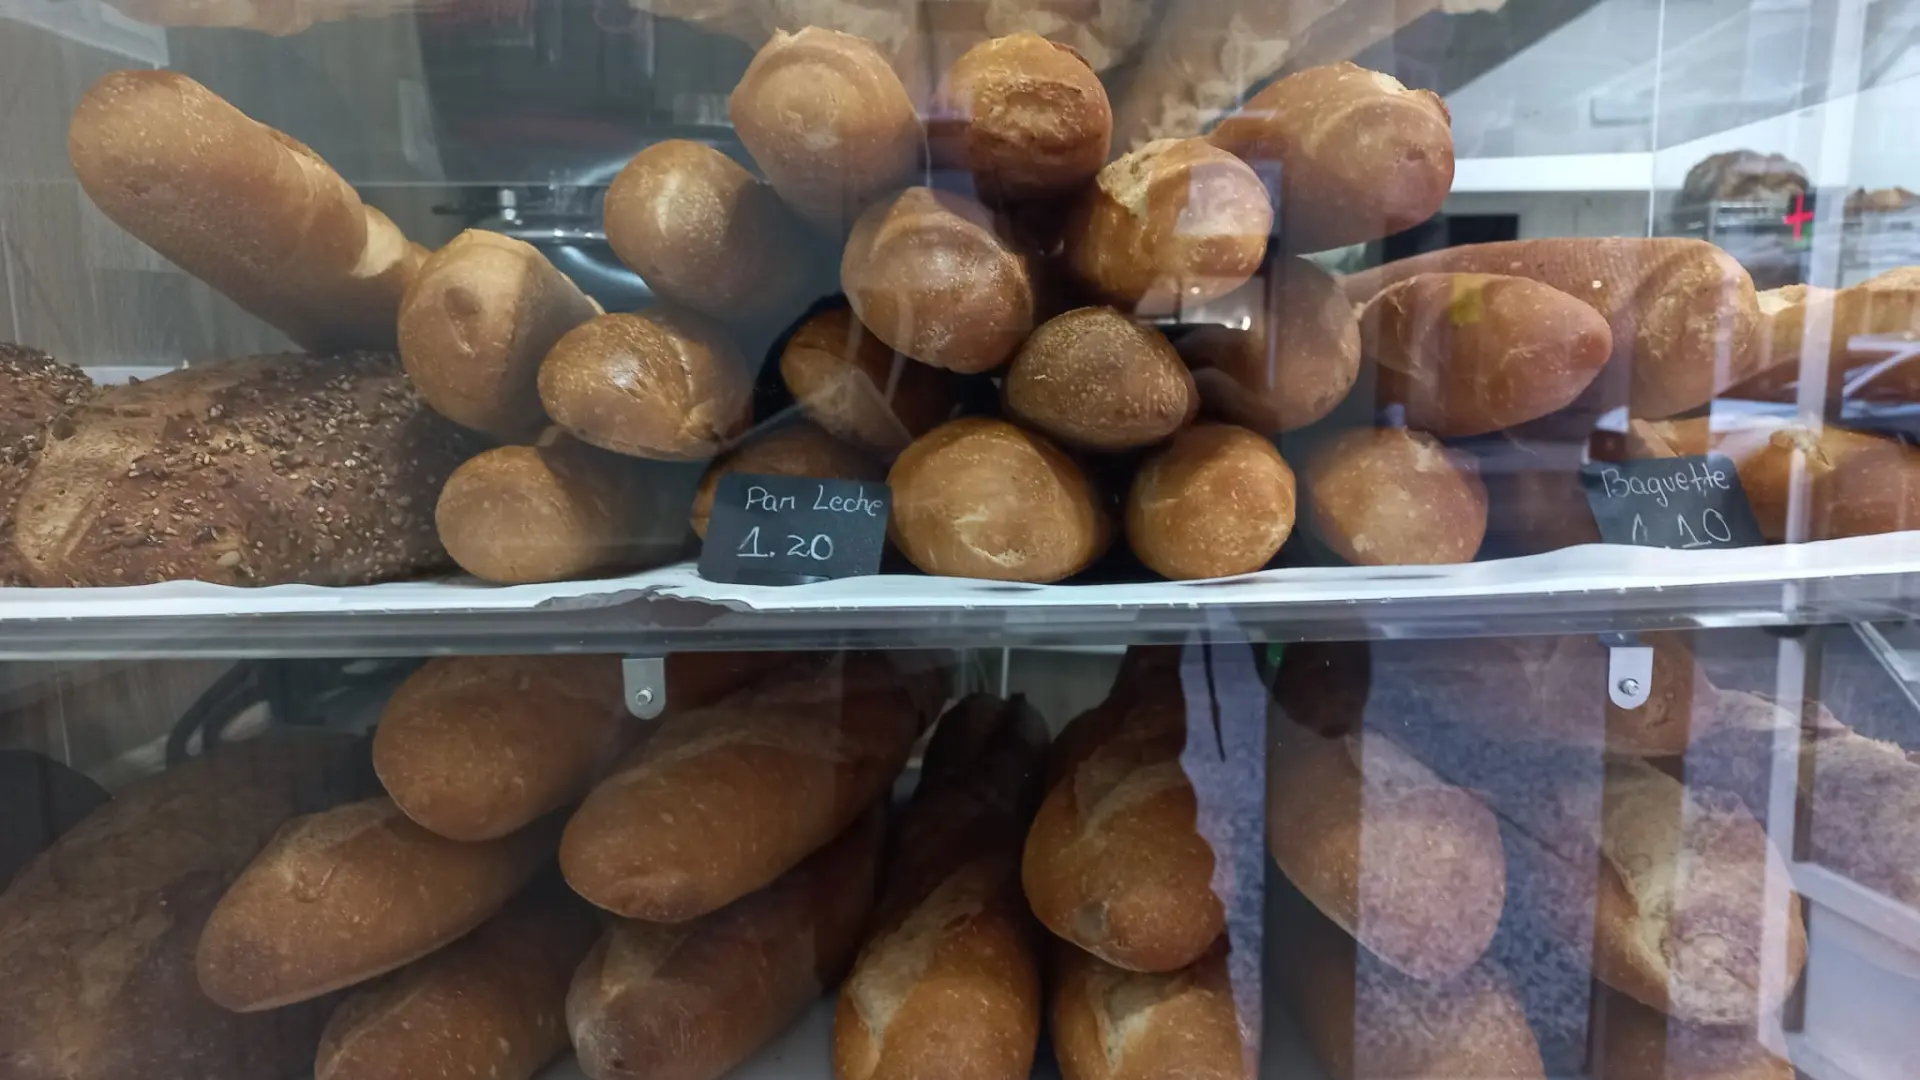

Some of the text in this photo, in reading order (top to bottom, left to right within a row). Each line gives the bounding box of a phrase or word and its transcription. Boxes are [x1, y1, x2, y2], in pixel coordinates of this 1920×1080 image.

[745, 484, 883, 517] Pan Leche
[1601, 462, 1730, 507] Baguette
[736, 526, 834, 560] 1.20
